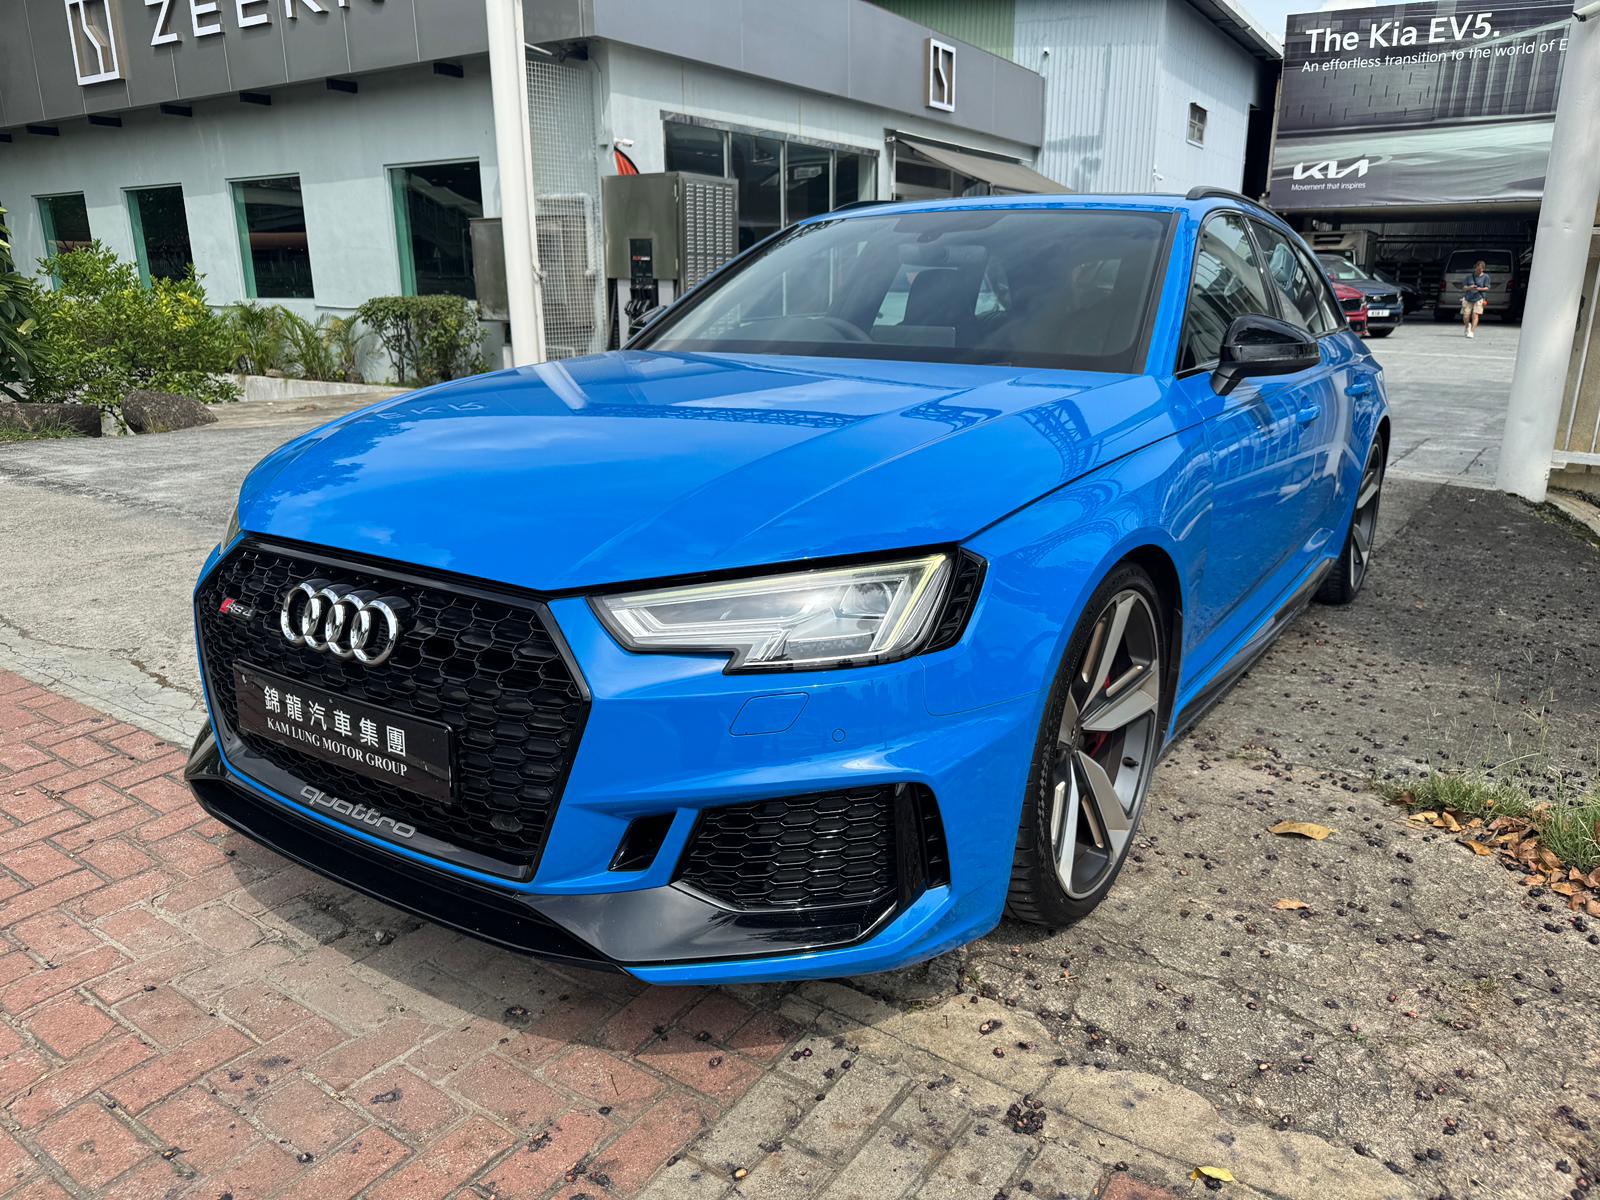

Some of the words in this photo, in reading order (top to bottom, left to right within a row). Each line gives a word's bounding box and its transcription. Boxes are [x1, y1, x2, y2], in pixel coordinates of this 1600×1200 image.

[144, 0, 372, 46] ZEE
[1305, 28, 1360, 54] The
[1369, 21, 1418, 49] Kia
[1428, 12, 1500, 44] EV5.
[1301, 60, 1319, 73] An
[1321, 56, 1381, 72] effortless
[1385, 51, 1447, 66] transition
[1451, 50, 1465, 61] to
[1469, 47, 1490, 59] the
[1495, 41, 1535, 57] world
[1539, 40, 1555, 53] of
[1290, 183, 1325, 191] Movement
[1326, 182, 1340, 190] that
[1341, 181, 1366, 191] inspires
[263, 685, 406, 758] 錦龍汽車集團
[267, 717, 290, 736] KAM
[292, 725, 320, 747] LUNG
[322, 736, 364, 762] MOTOR
[365, 752, 408, 777] GROUP
[299, 783, 416, 839] quattro
